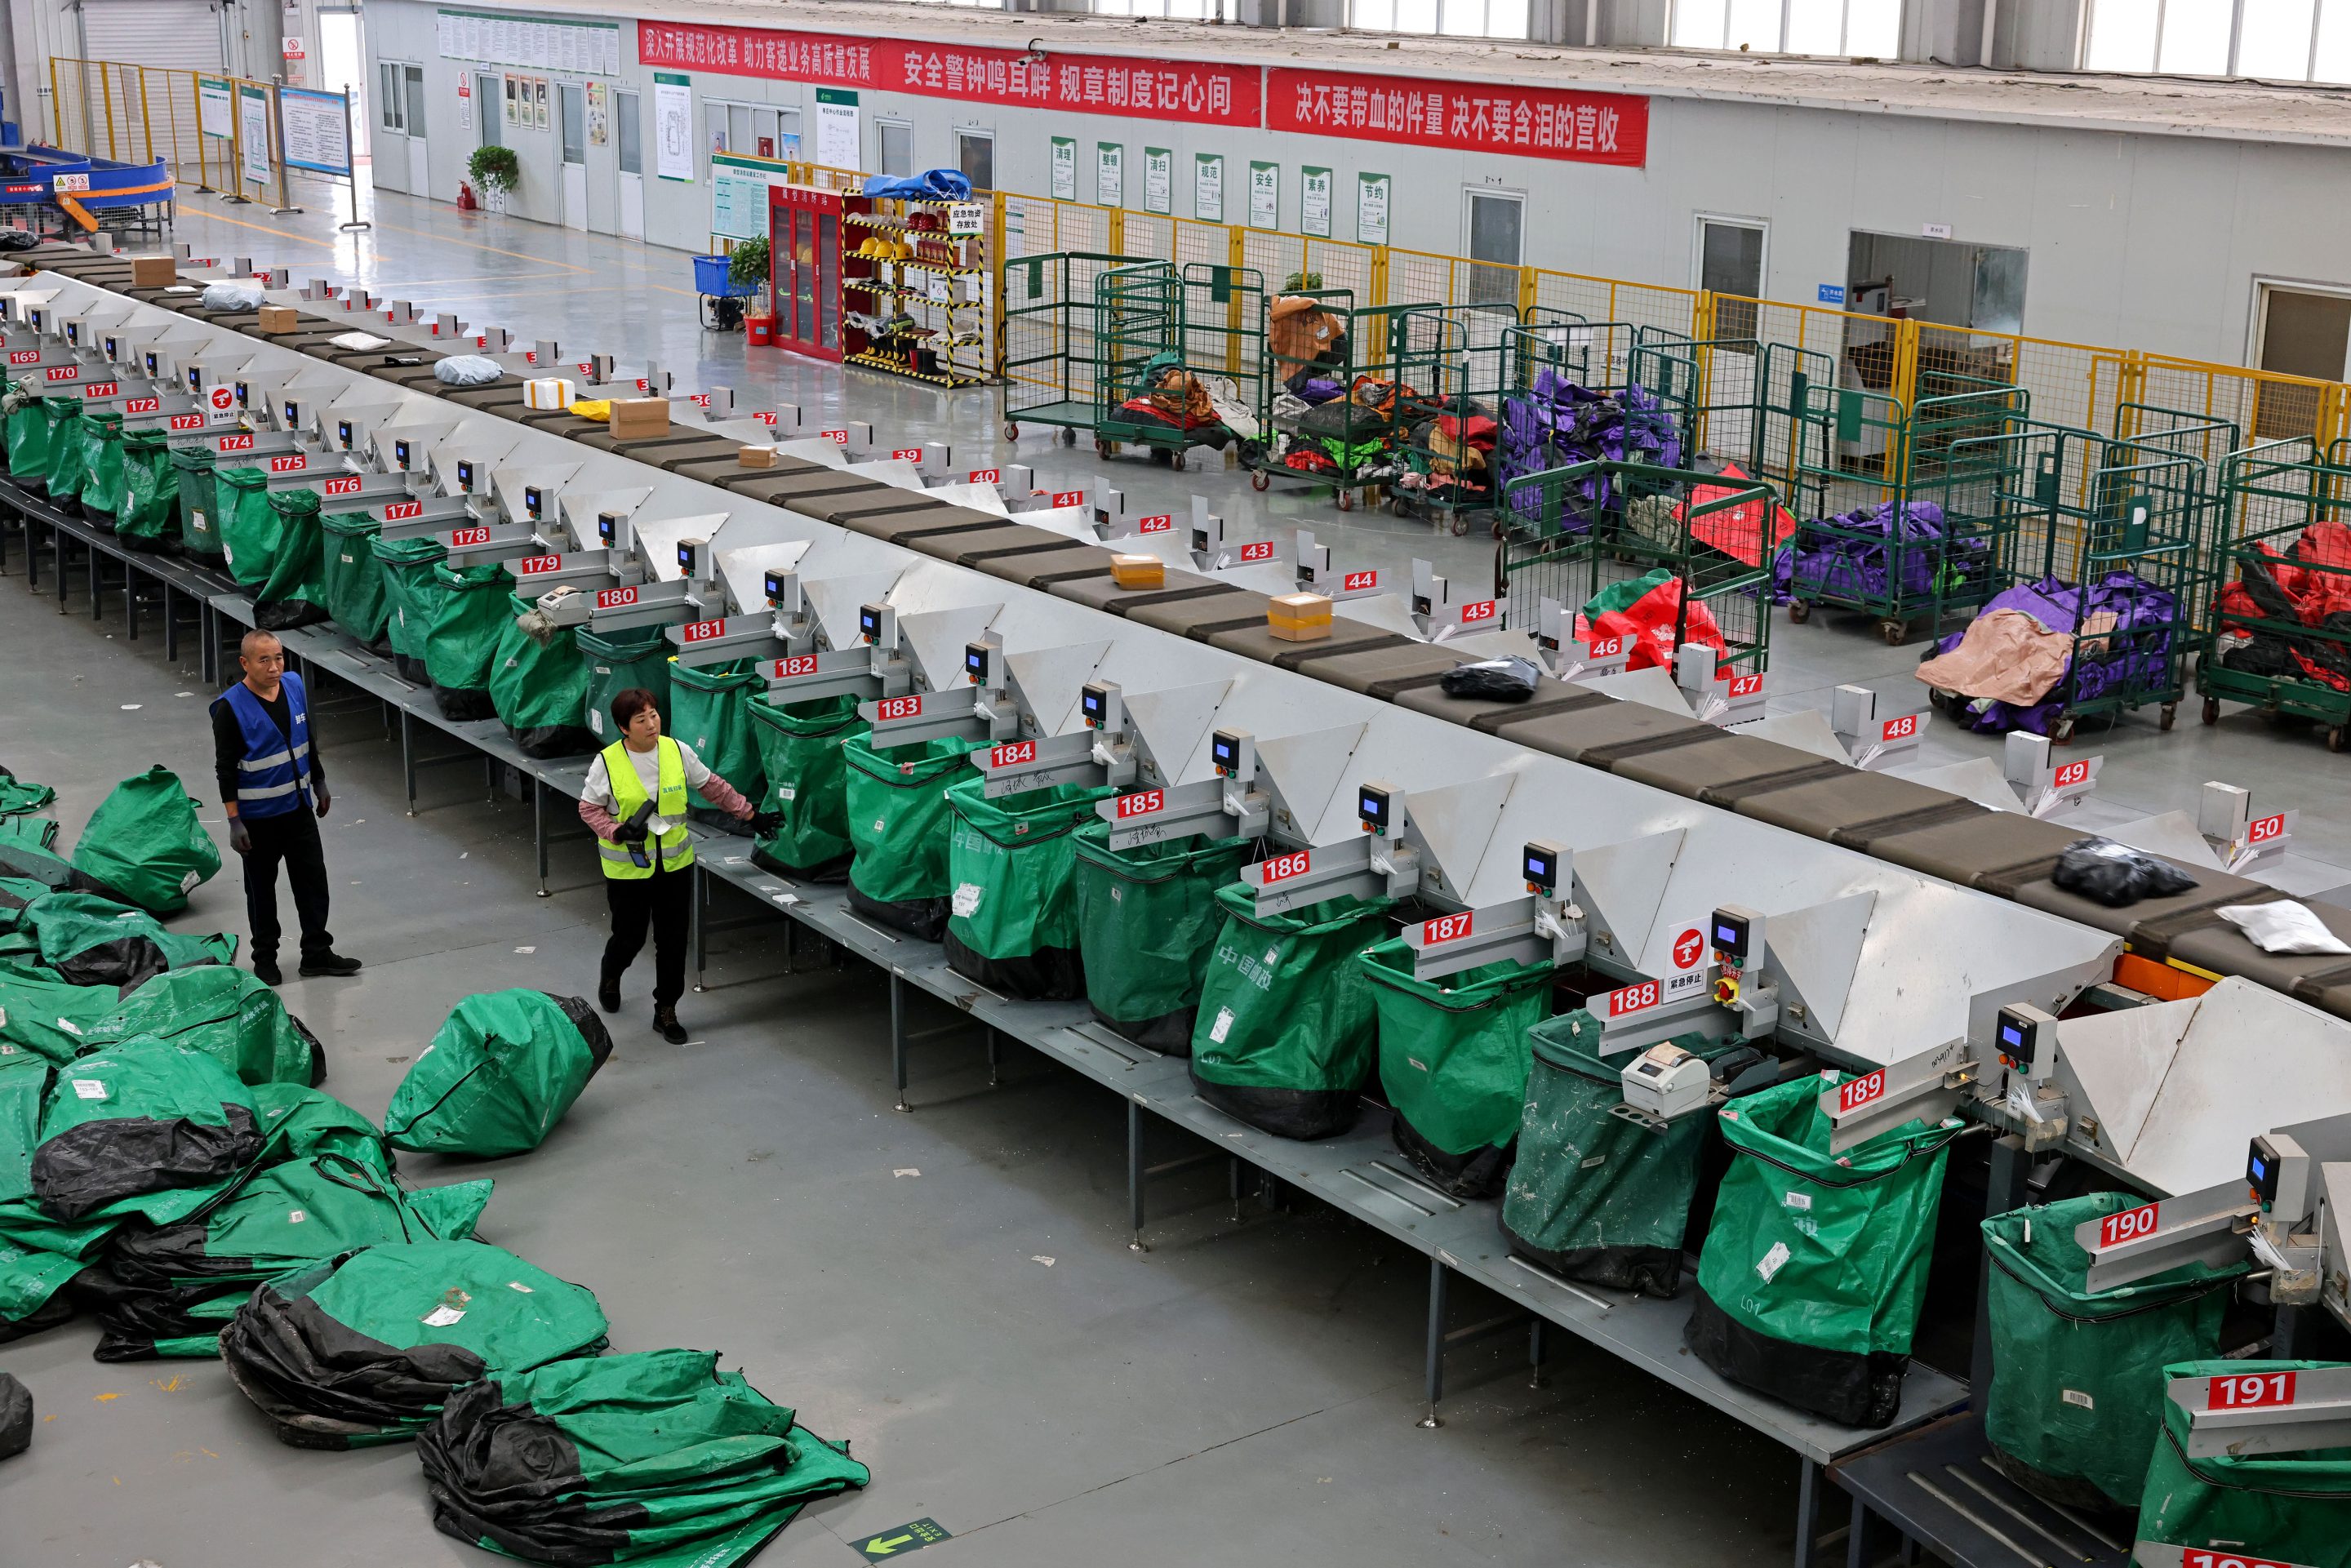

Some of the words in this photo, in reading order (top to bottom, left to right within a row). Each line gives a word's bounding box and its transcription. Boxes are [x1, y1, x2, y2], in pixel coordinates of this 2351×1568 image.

[646, 29, 737, 67] 深入开展规范化改革
[744, 37, 870, 80] 助力寄递业务高质量发展
[904, 51, 1051, 100] 安全警钟鸣耳畔
[1060, 64, 1231, 115] 规章制度记心间
[1295, 82, 1443, 135] 决不要带血的件量
[1451, 95, 1619, 153] 决不要含泪的营收
[1056, 147, 1071, 161] 清理
[1102, 153, 1118, 167] 整顿
[1150, 158, 1166, 172] 清扫
[1202, 166, 1217, 179] 规范
[1255, 173, 1273, 187] 安全
[1308, 179, 1325, 193] 素养
[782, 189, 828, 206] 微型消防站
[1364, 184, 1384, 200] 节约
[953, 209, 981, 219] 应急物资
[956, 220, 978, 229] 存放处
[13, 352, 37, 362] 169
[50, 367, 74, 379] 170
[89, 384, 113, 396] 171
[130, 399, 156, 411] 172
[175, 415, 201, 428] 173
[222, 437, 251, 449] 174
[275, 457, 303, 469] 175
[897, 451, 918, 461] 39
[974, 471, 996, 483] 40
[328, 479, 358, 493] 176
[1058, 493, 1078, 506] 41
[389, 503, 419, 518] 177
[1144, 517, 1167, 531] 42
[456, 529, 487, 544] 178
[1246, 544, 1269, 558] 43
[526, 557, 558, 572] 179
[1349, 573, 1373, 587] 44
[601, 589, 634, 606] 180
[1466, 602, 1490, 619] 45
[690, 620, 721, 639] 181
[1593, 639, 1618, 655] 46
[780, 657, 813, 675] 182
[1733, 677, 1757, 694] 47
[882, 699, 917, 717] 183
[1887, 717, 1913, 736] 48
[994, 744, 1033, 765] 184
[2059, 763, 2085, 783] 49
[1122, 792, 1160, 815] 185
[2254, 817, 2279, 840] 50
[1266, 853, 1306, 880] 186
[1428, 914, 1469, 941] 187
[1218, 945, 1273, 992] 中国邮政
[1614, 984, 1655, 1012] 188
[1844, 1073, 1882, 1106] 189
[2106, 1207, 2154, 1242] 190
[2220, 1375, 2286, 1405] 191
[922, 1522, 942, 1537] EXIT
